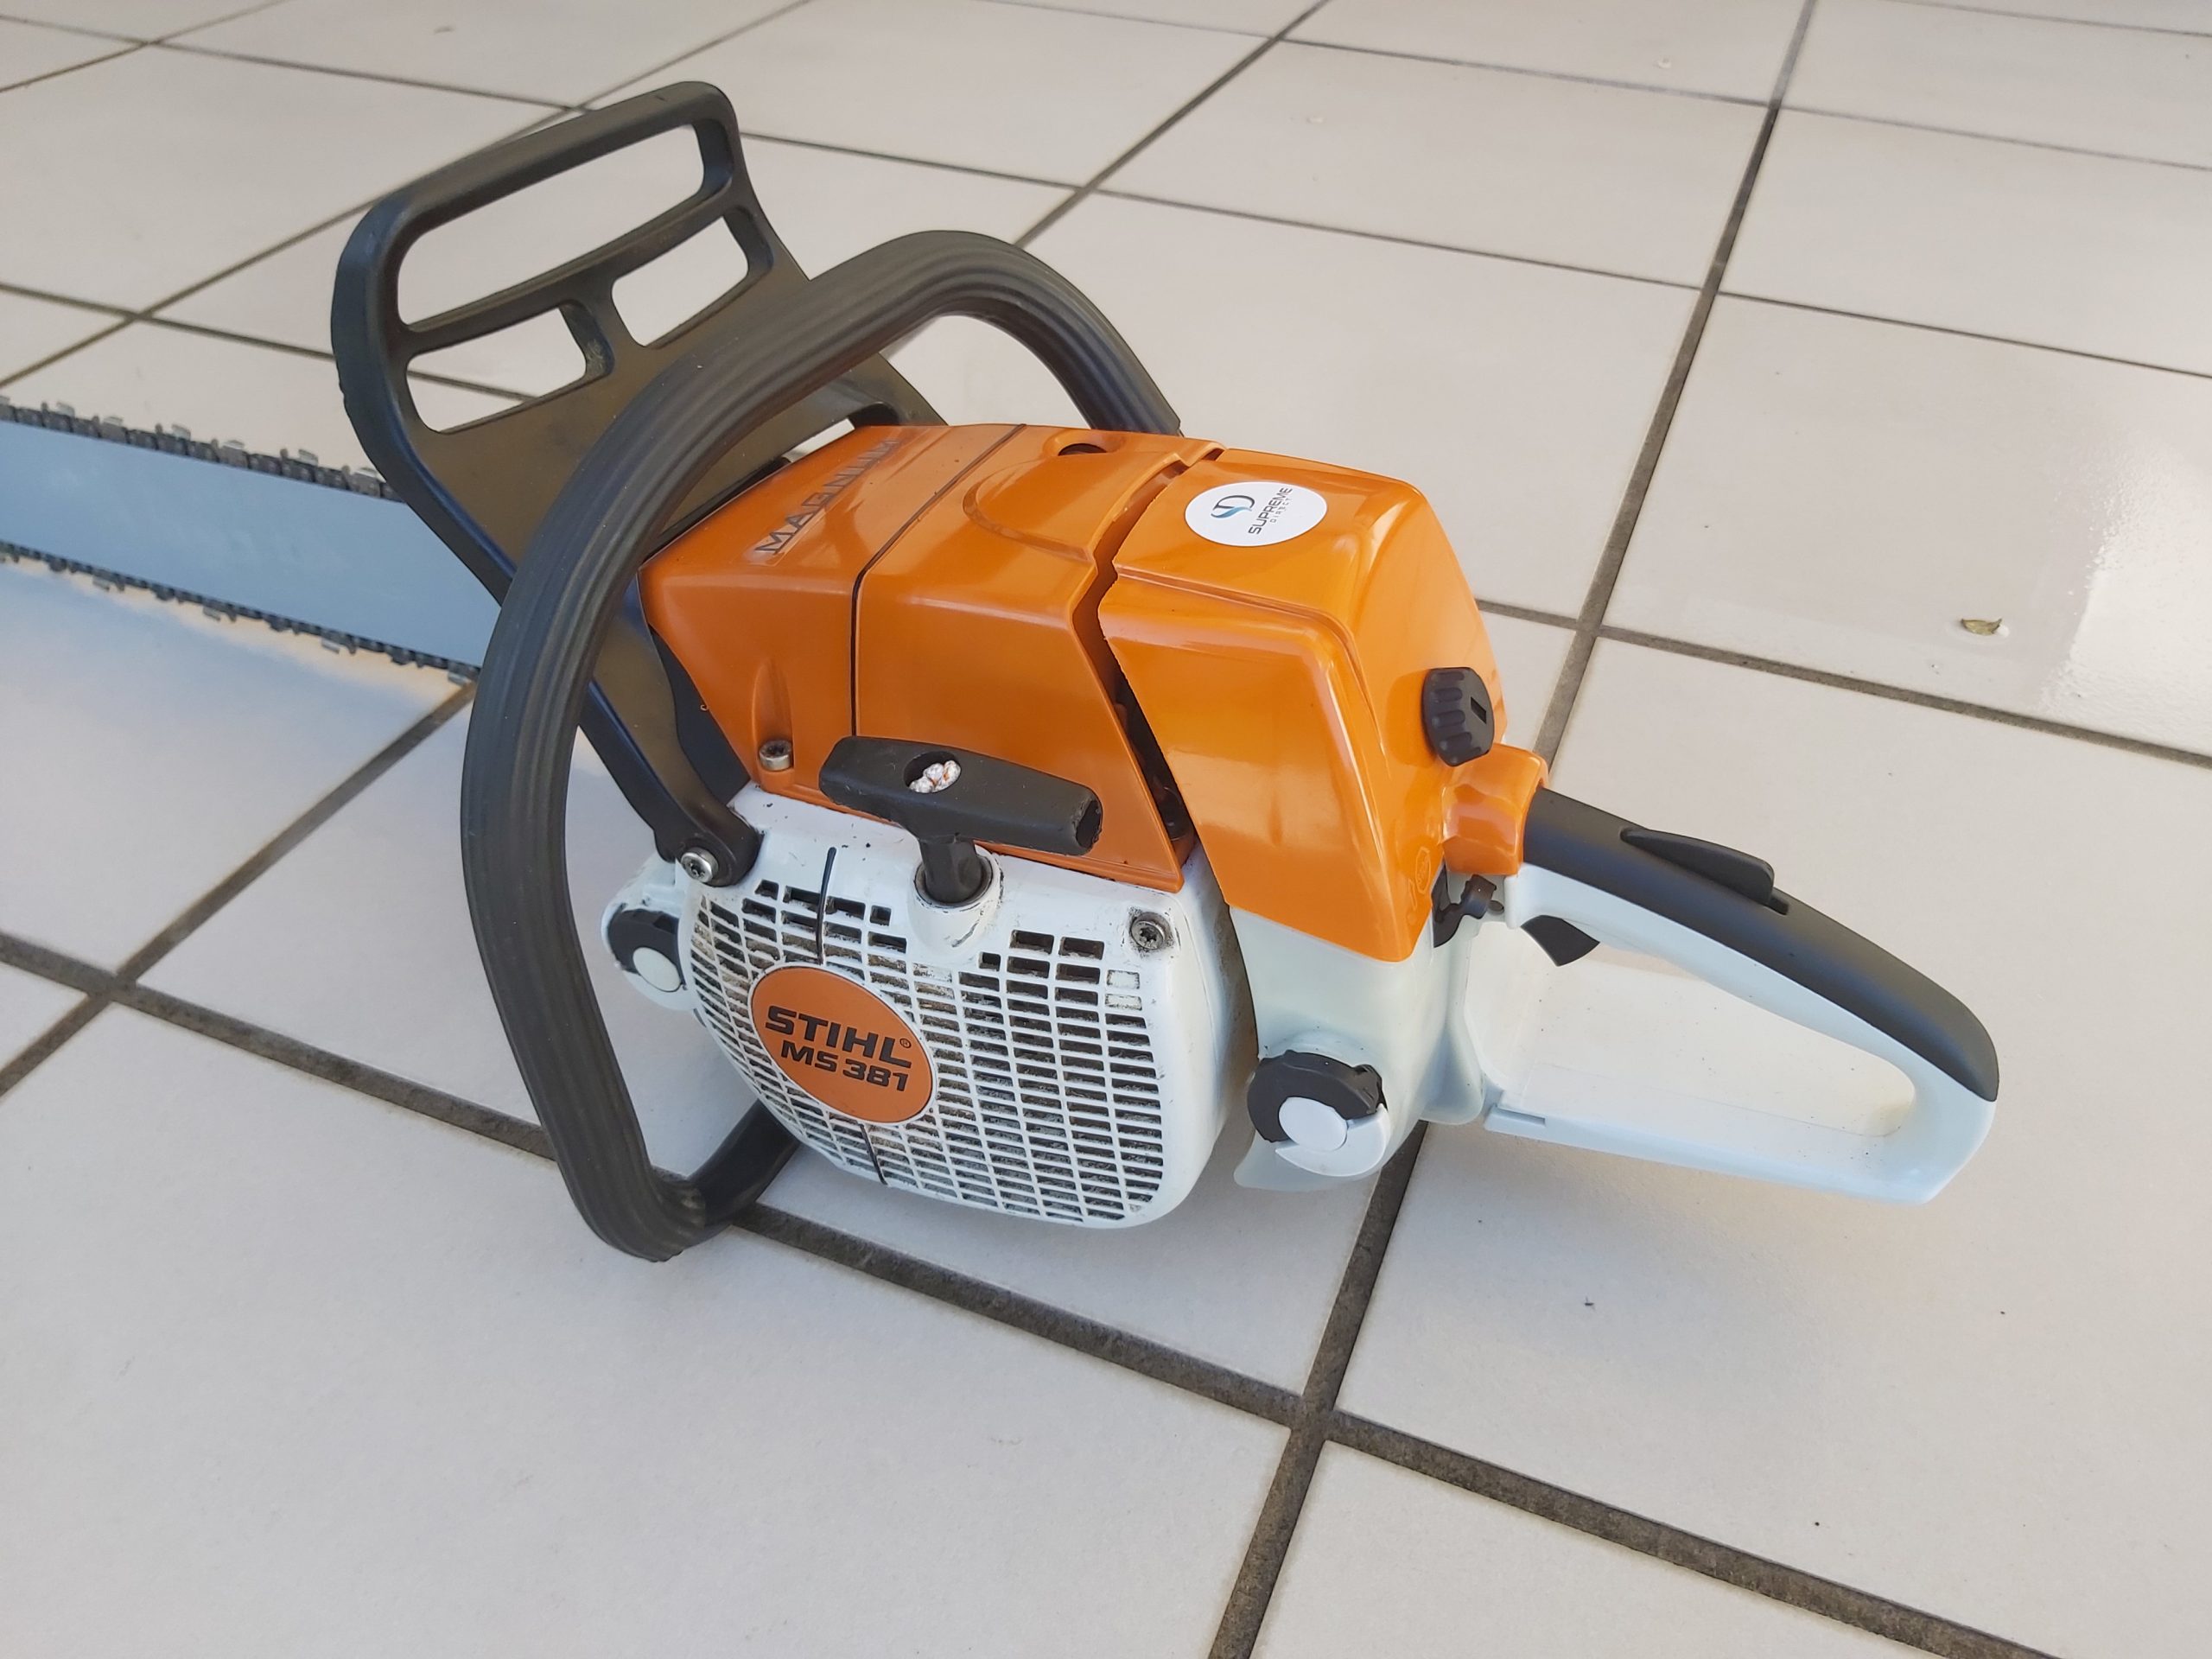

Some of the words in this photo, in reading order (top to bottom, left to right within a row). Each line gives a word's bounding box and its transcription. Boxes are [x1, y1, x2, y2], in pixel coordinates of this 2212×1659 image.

[1249, 487, 1293, 534] SUPREME
[781, 1040, 838, 1071] MS
[842, 1058, 908, 1091] 381
